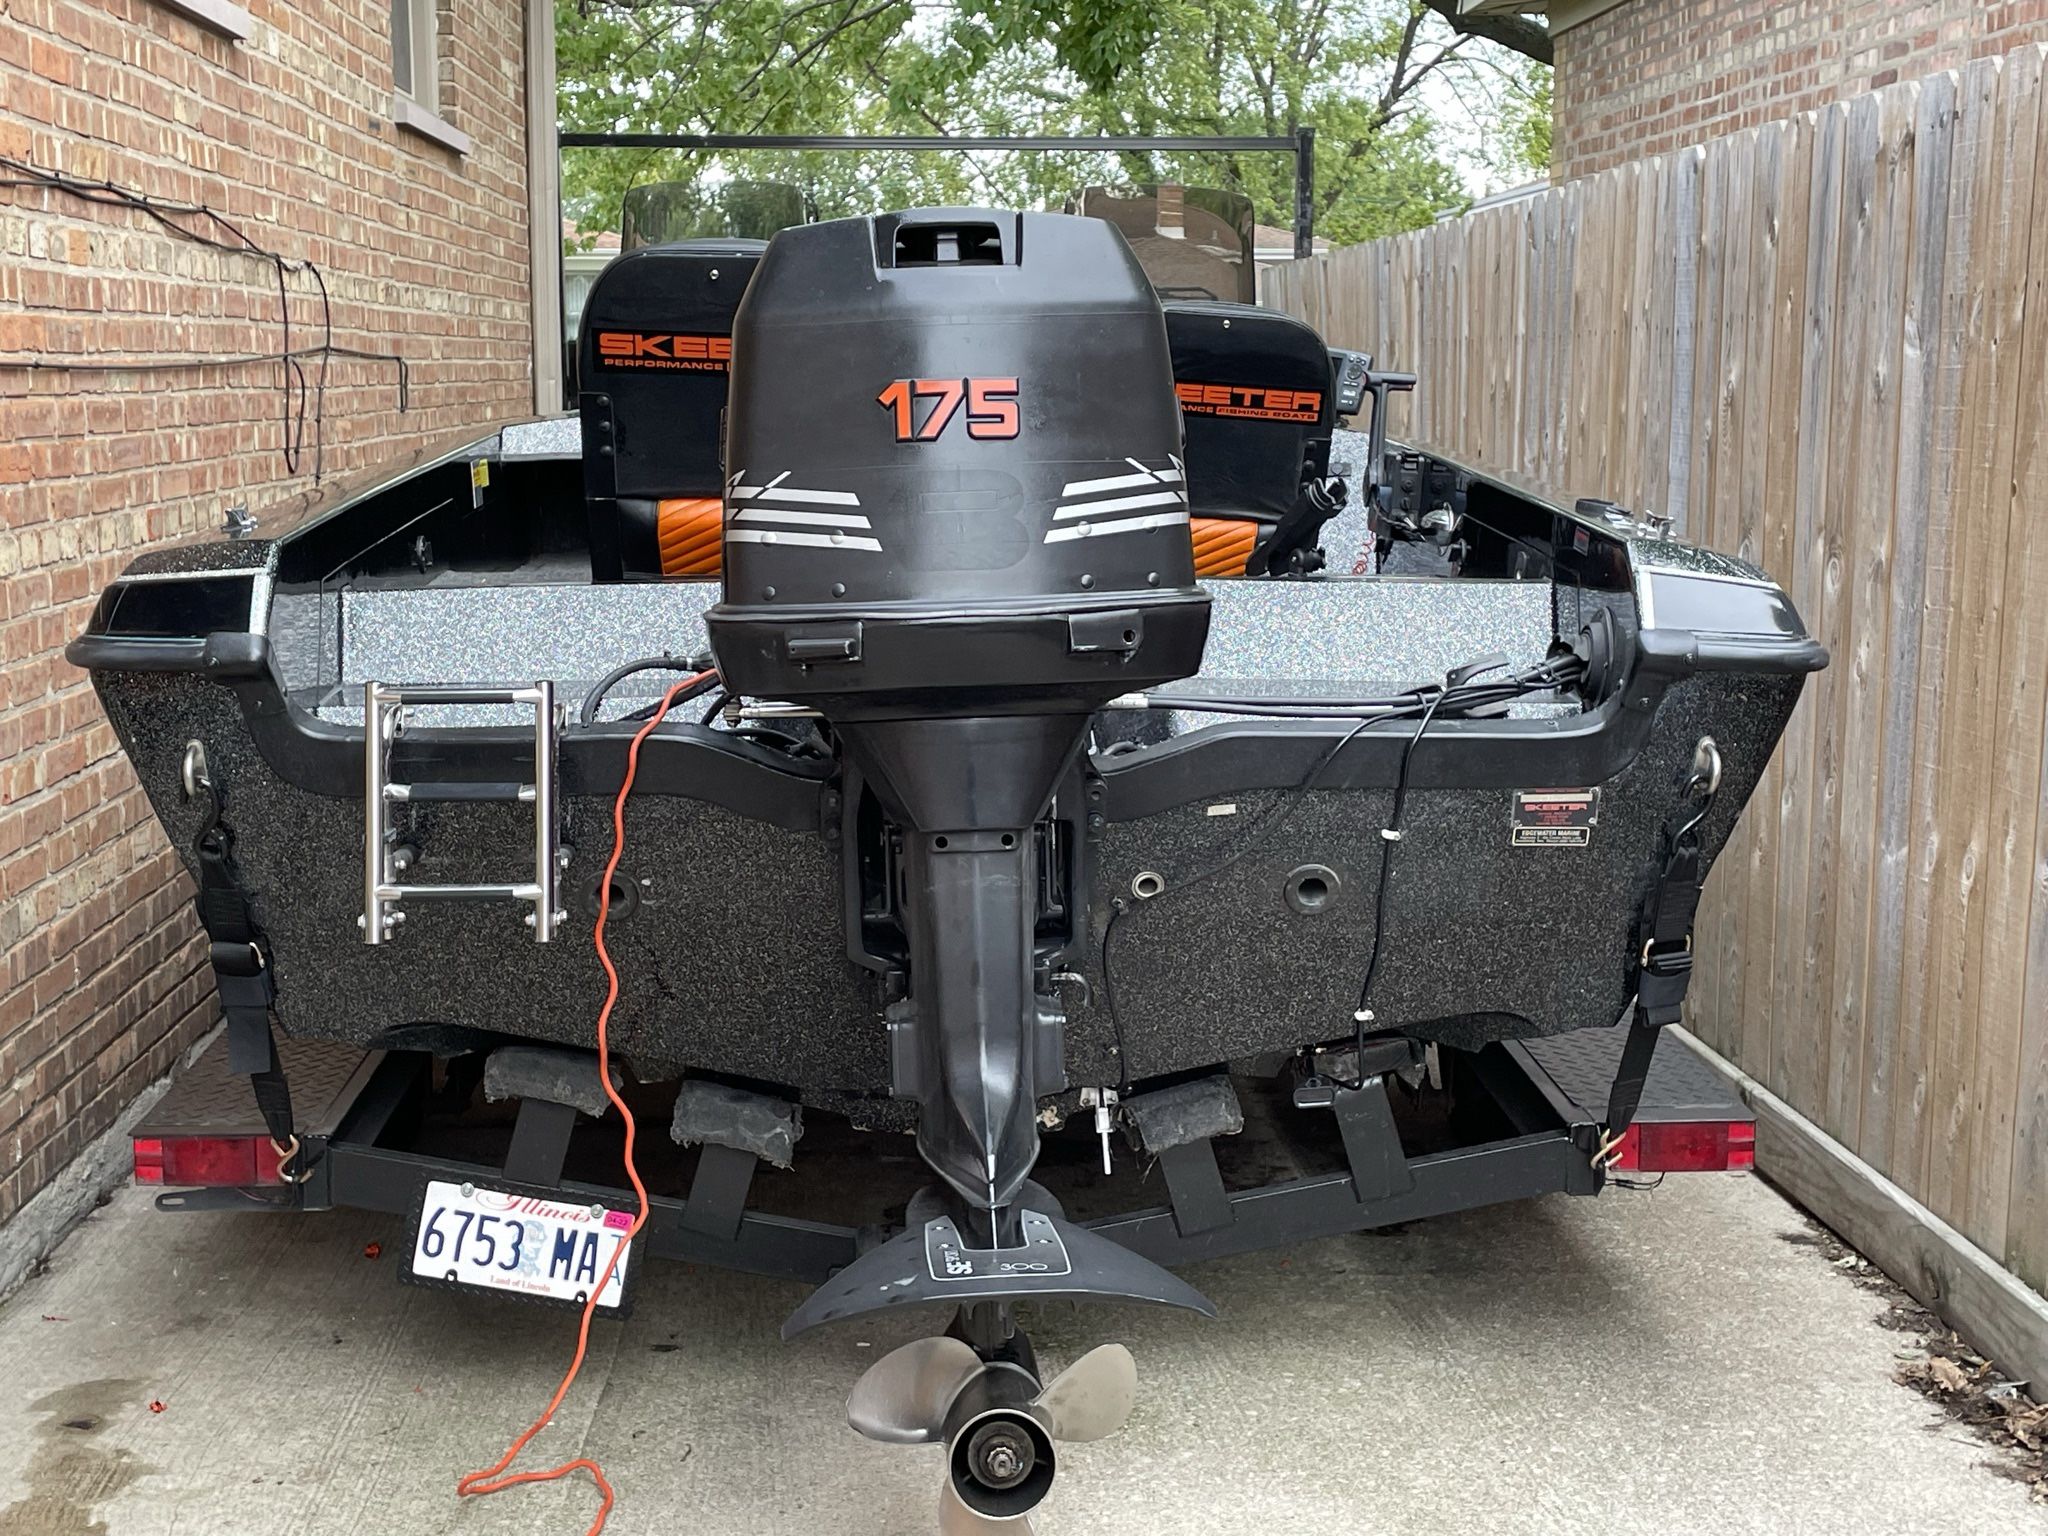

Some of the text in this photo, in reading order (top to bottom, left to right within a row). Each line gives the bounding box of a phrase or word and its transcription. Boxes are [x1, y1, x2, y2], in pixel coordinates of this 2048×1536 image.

[604, 358, 723, 371] PERFORMANCE
[1175, 383, 1321, 411] EETER
[875, 377, 1020, 443] 175
[1217, 406, 1270, 417] FISHING
[1272, 411, 1315, 420] BOATS
[1524, 803, 1588, 812] SKEETER
[475, 1189, 592, 1224] Illinois
[422, 1206, 600, 1285] 6753 MA
[1000, 1262, 1048, 1271] 300
[490, 1275, 511, 1286] Land
[521, 1280, 551, 1292] Lincoln
